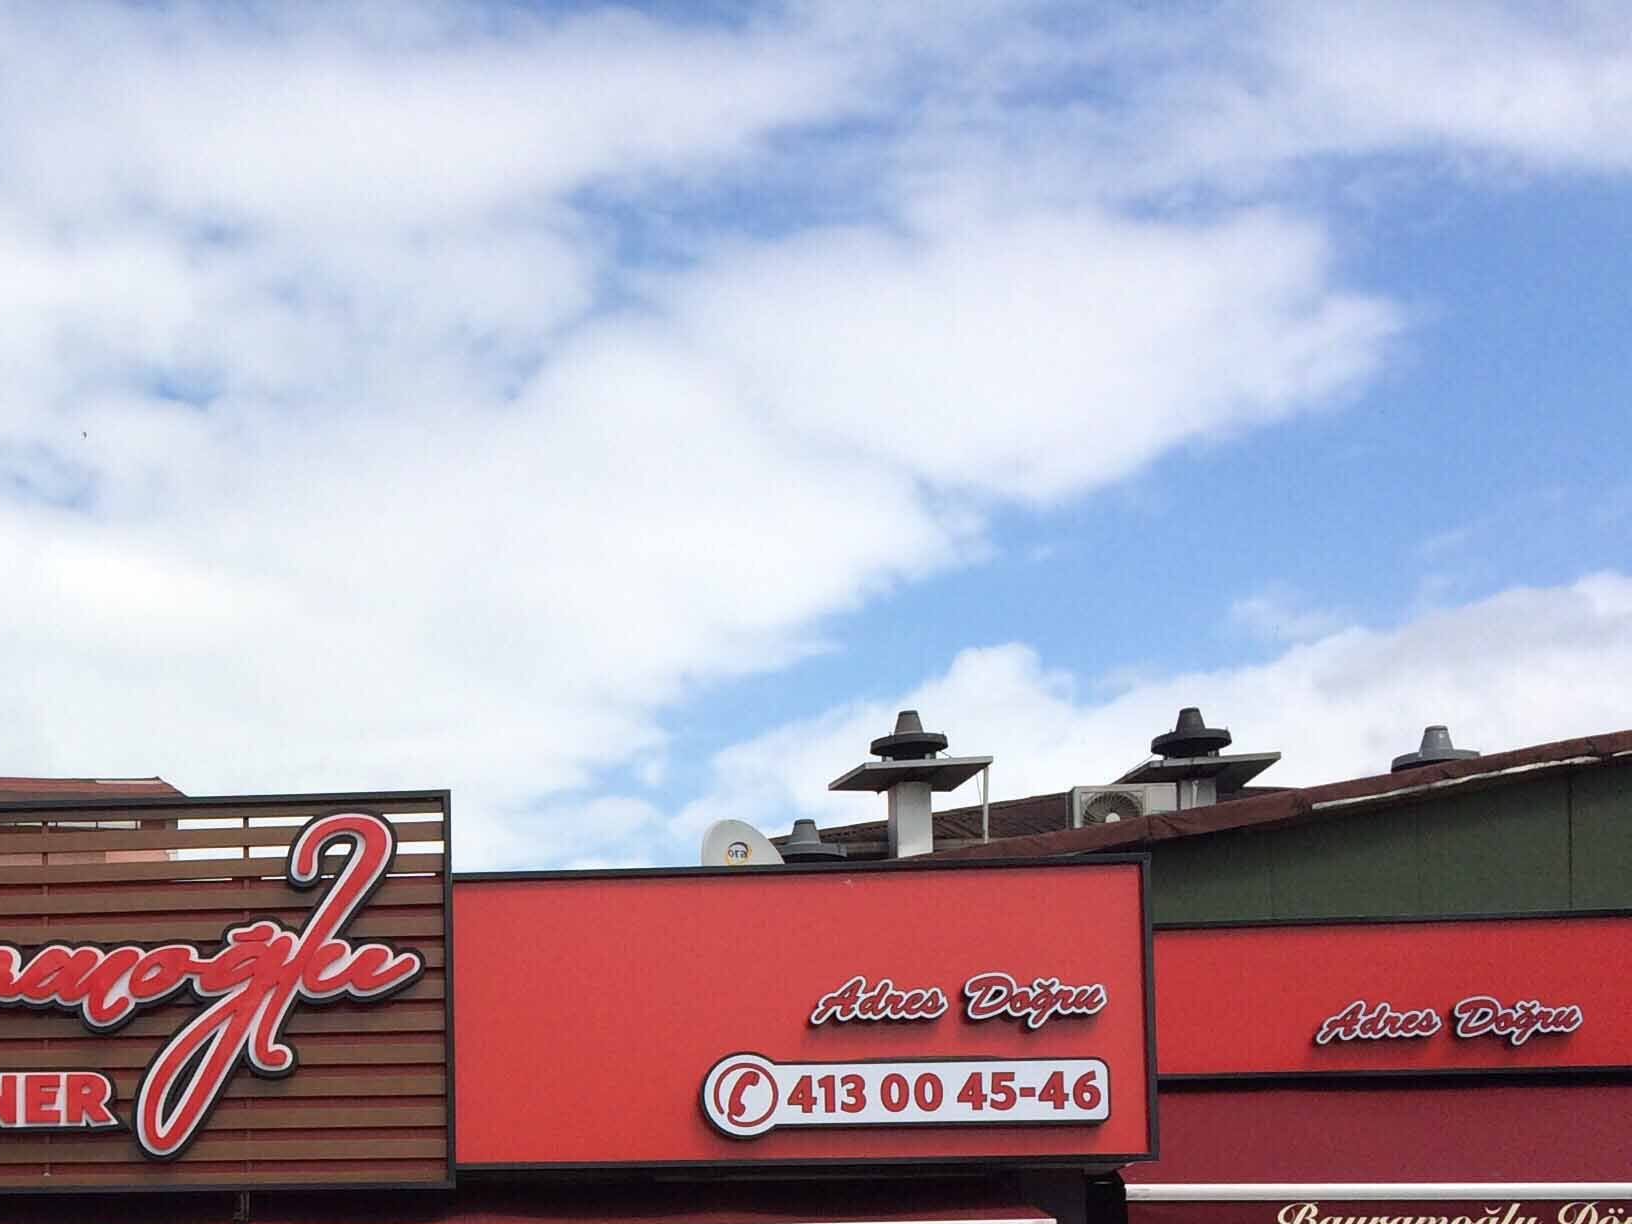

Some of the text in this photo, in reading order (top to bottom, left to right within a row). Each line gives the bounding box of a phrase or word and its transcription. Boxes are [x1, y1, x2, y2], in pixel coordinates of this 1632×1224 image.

[809, 971, 1108, 1030] Adres Doğru
[1315, 995, 1584, 1046] Adres Doğru
[788, 1070, 1102, 1114] 413 00 45-46
